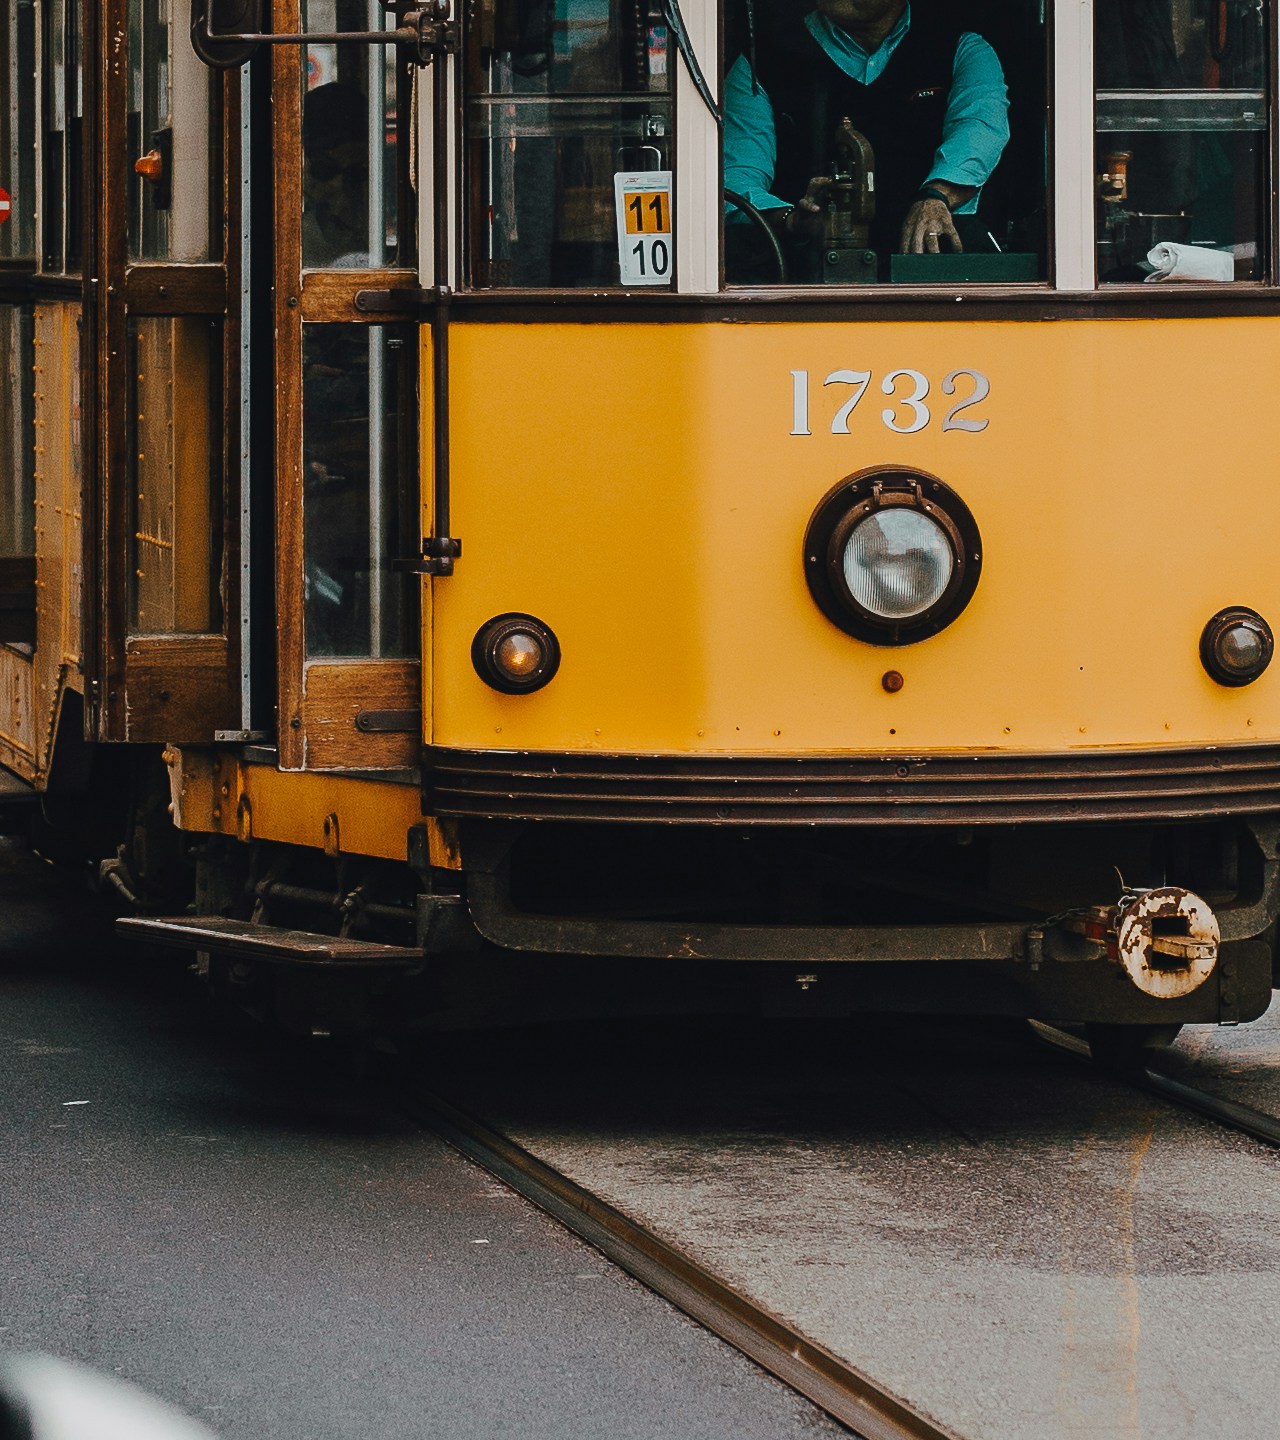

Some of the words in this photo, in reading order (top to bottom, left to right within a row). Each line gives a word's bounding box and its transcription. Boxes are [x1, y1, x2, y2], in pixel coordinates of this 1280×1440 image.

[629, 194, 663, 232] 11
[632, 239, 669, 276] 10
[789, 369, 991, 436] 1732
